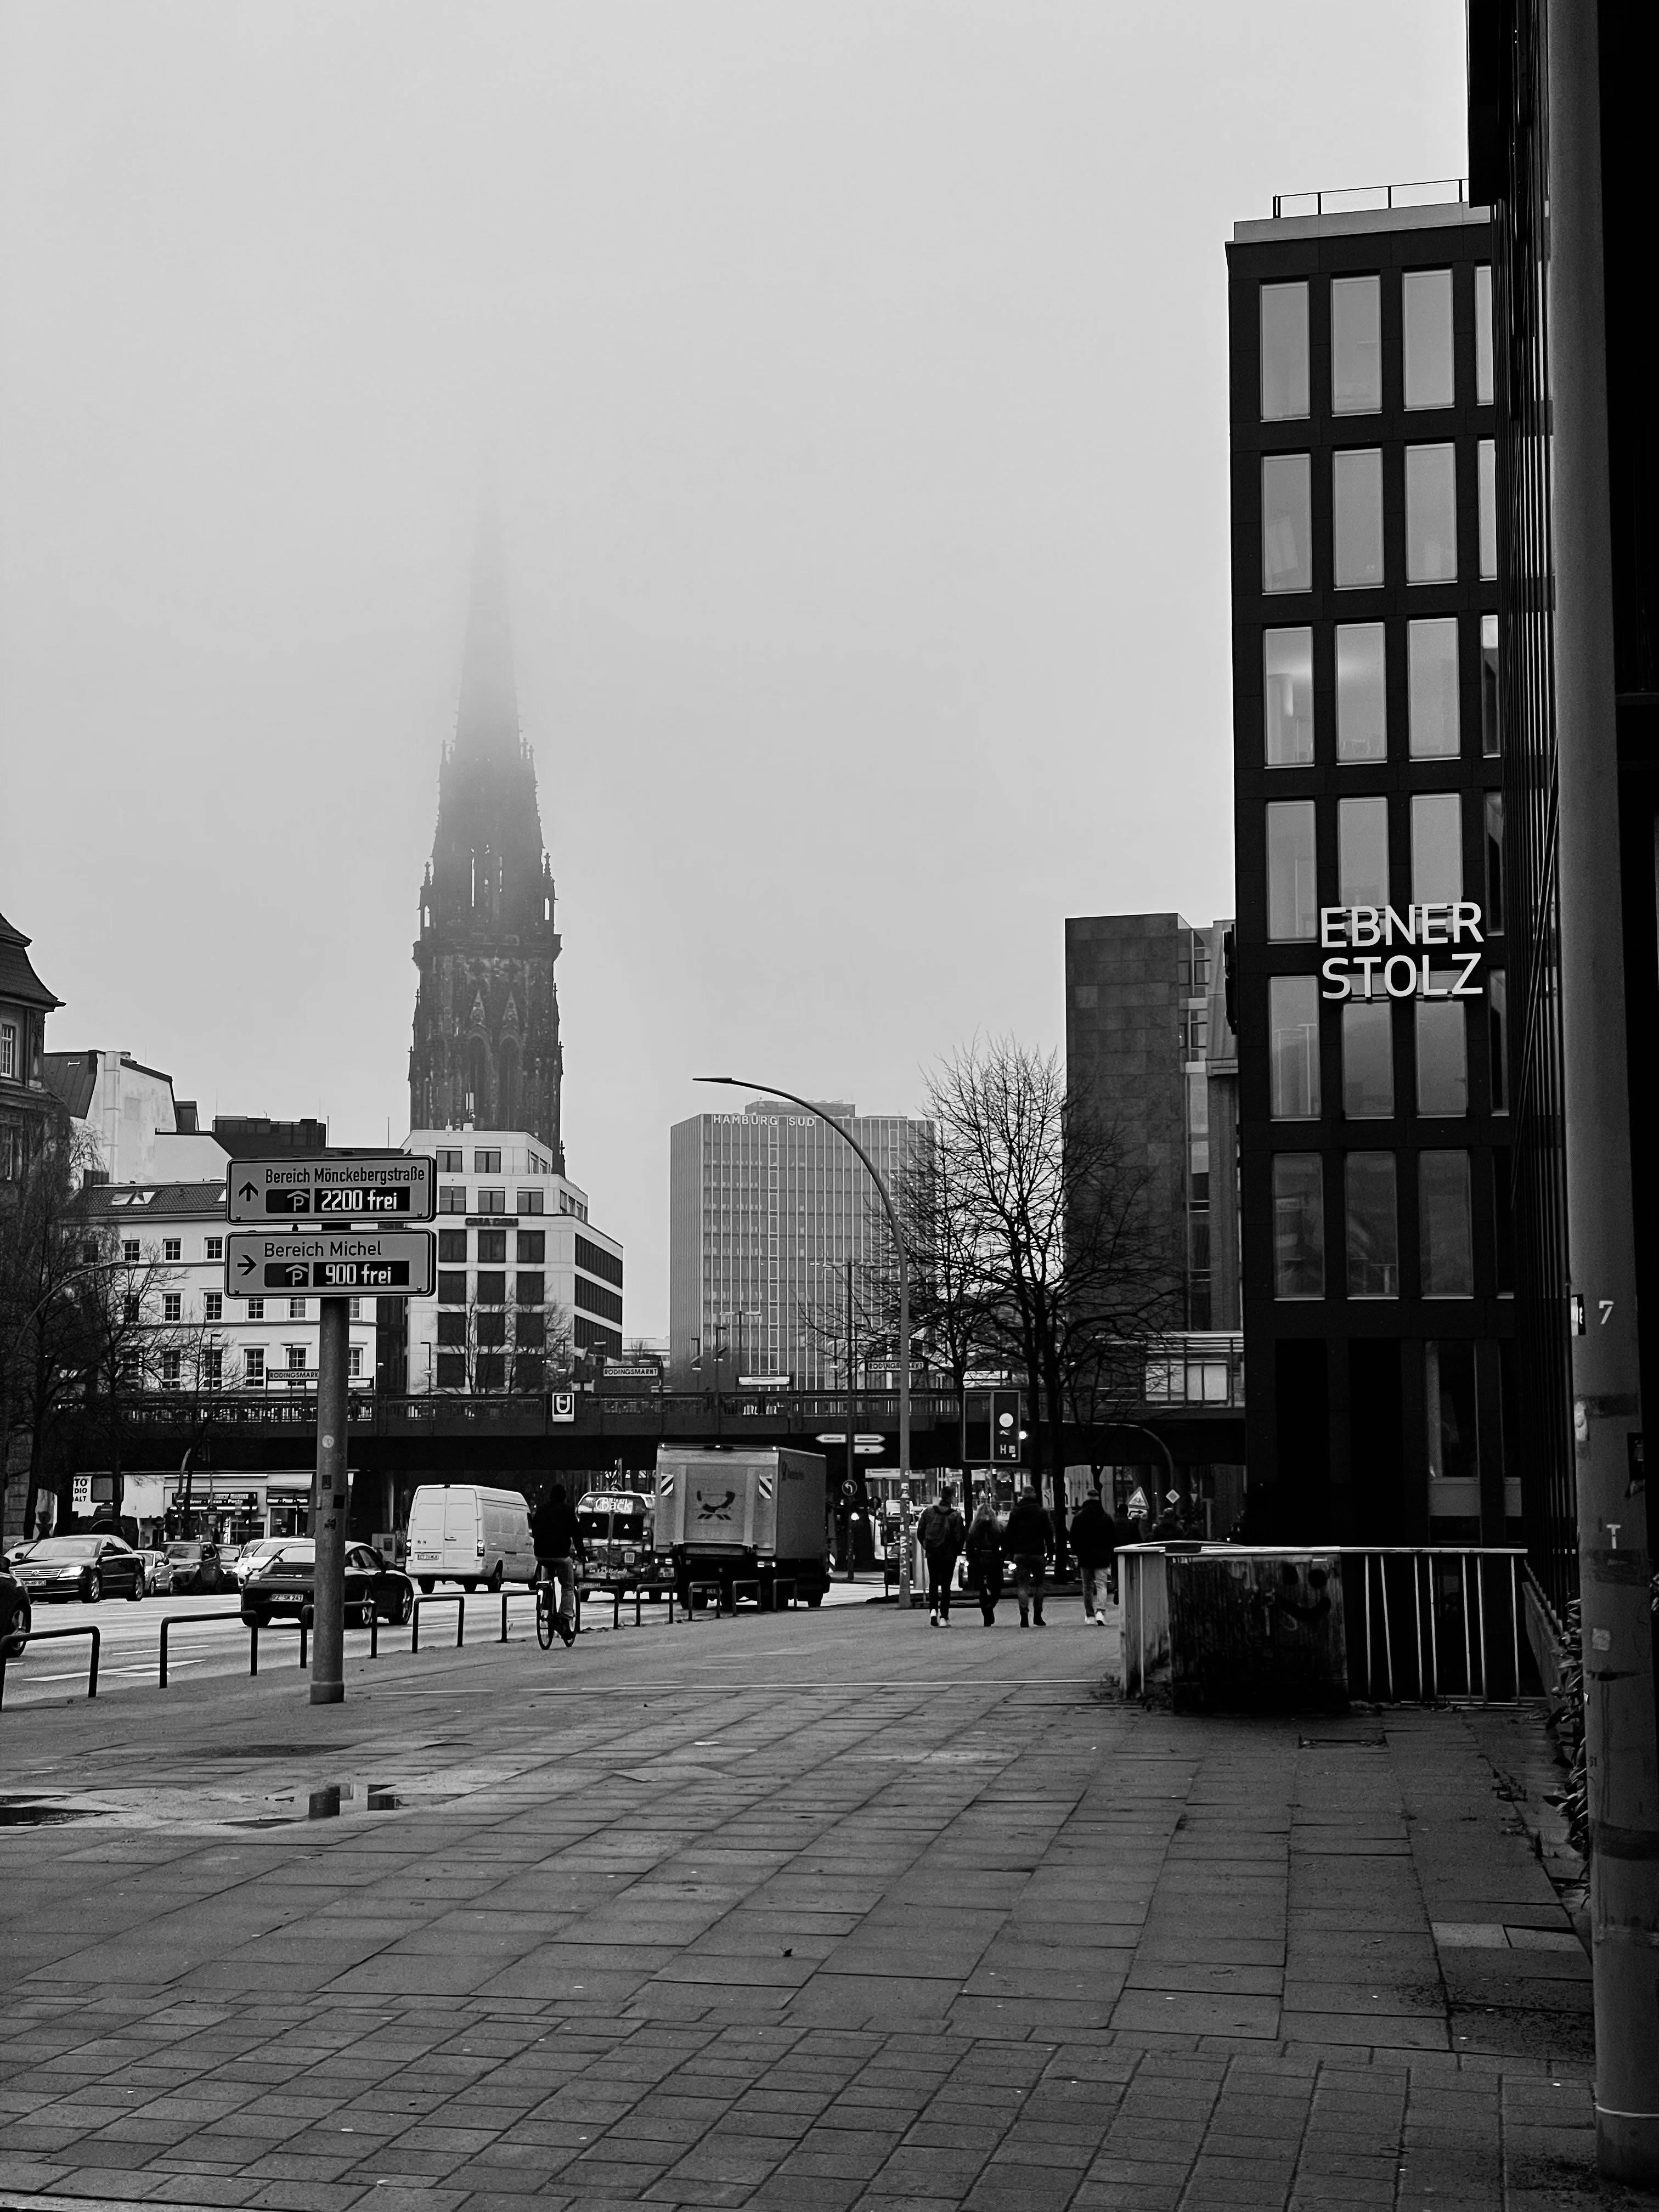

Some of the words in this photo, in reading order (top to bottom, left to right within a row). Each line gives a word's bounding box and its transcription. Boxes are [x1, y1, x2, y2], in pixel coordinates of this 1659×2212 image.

[1321, 901, 1485, 948] EBNER
[1322, 952, 1483, 1000] STOLZ
[713, 1114, 778, 1126] HAMBURG
[265, 1168, 311, 1184] Bereich
[314, 1166, 425, 1186] Mönckebergstraße
[321, 1189, 363, 1211] 2200
[367, 1189, 397, 1210] frei
[264, 1242, 324, 1257] Bereich
[330, 1240, 382, 1257] Michel
[325, 1263, 357, 1285] 900
[361, 1263, 392, 1284] frei
[1599, 1300, 1614, 1325] 7
[556, 1396, 571, 1414] U
